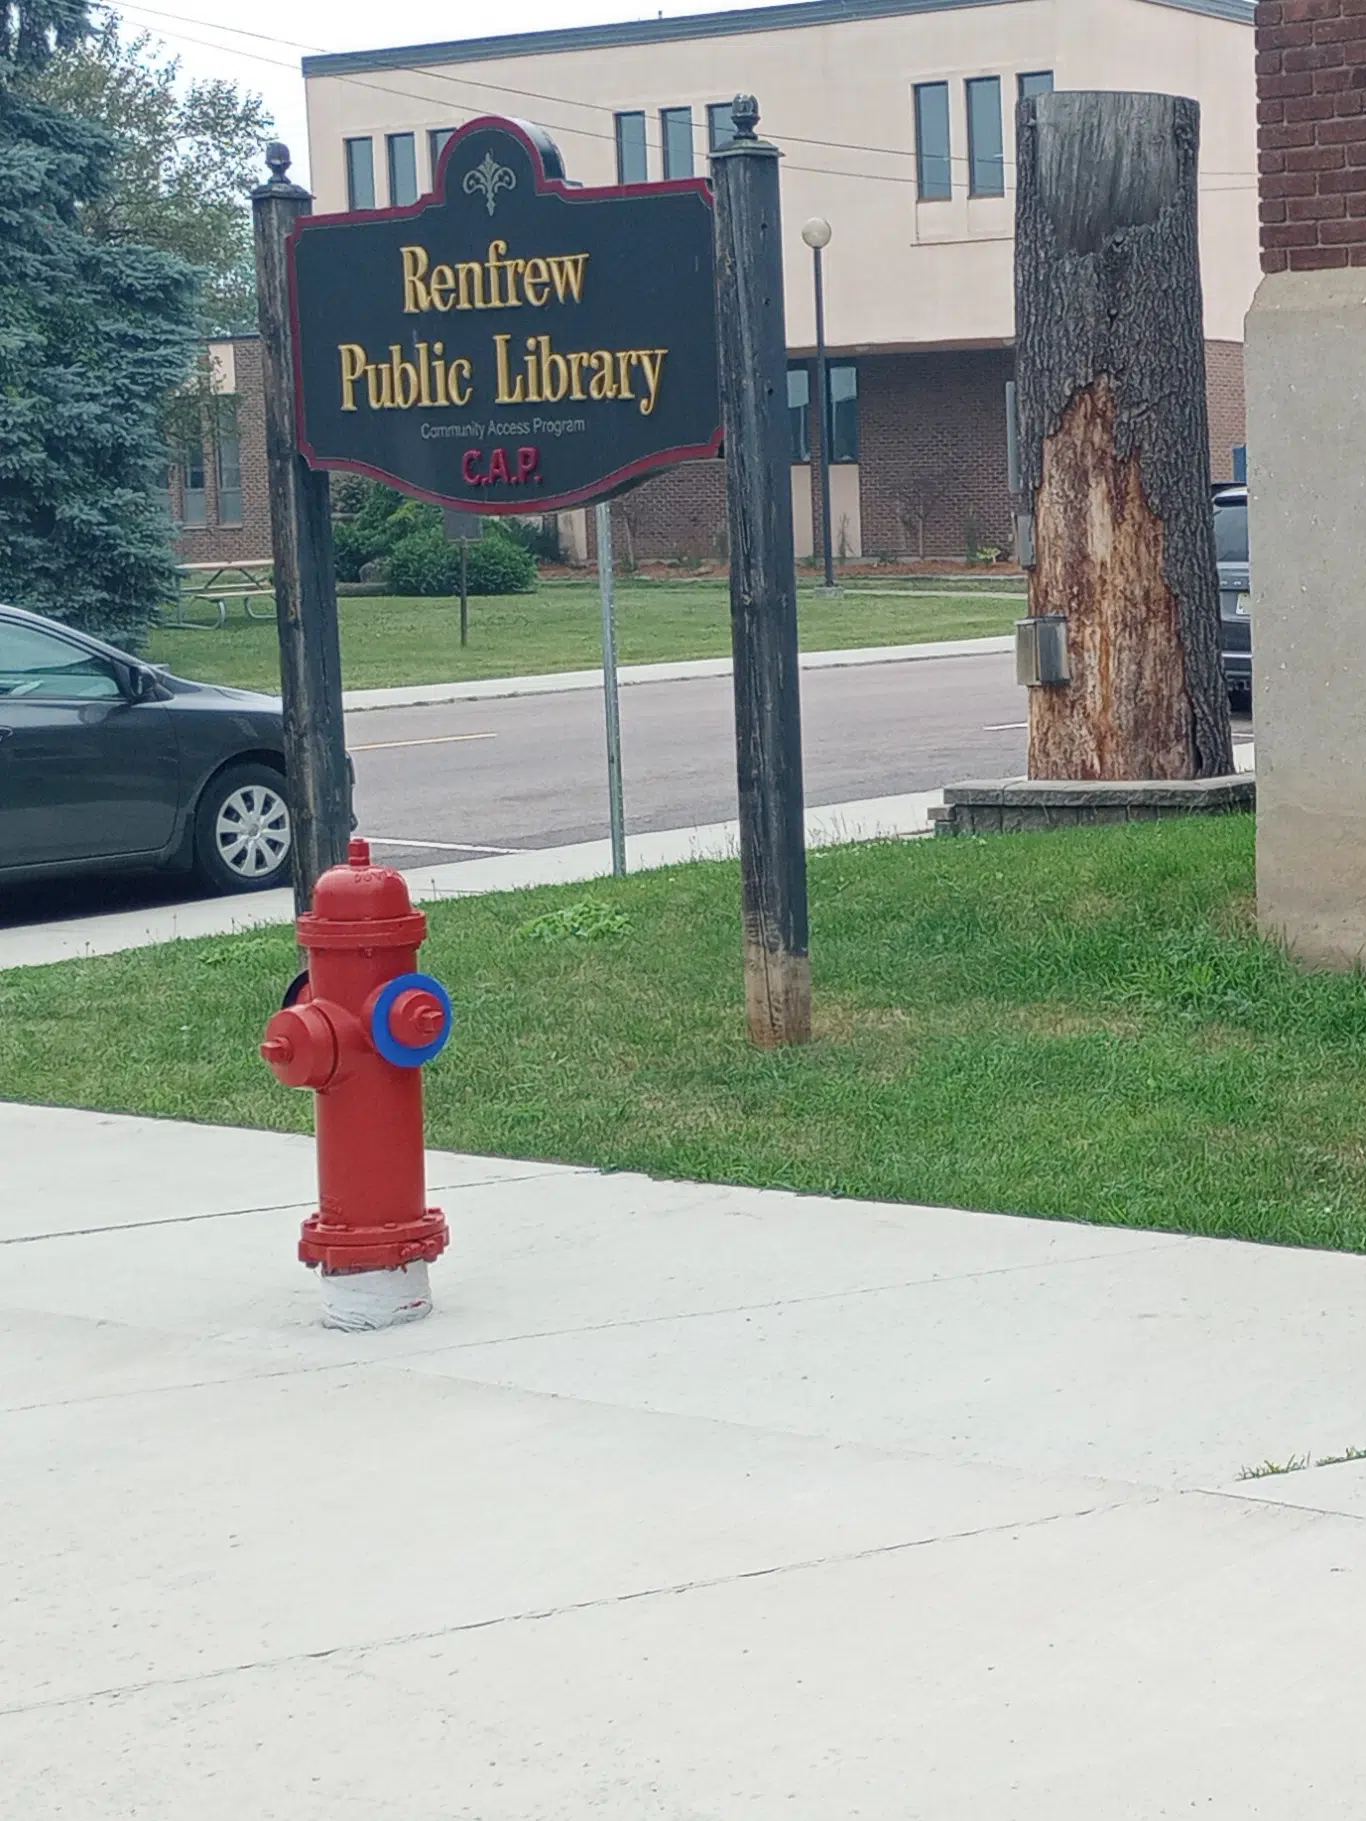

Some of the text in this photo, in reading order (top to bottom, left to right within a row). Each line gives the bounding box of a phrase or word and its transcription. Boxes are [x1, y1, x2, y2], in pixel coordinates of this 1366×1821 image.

[399, 239, 590, 314] Renfrew
[338, 334, 669, 415] Public Library
[420, 416, 586, 440] Community Access Program
[461, 446, 544, 485] C.A.P.
